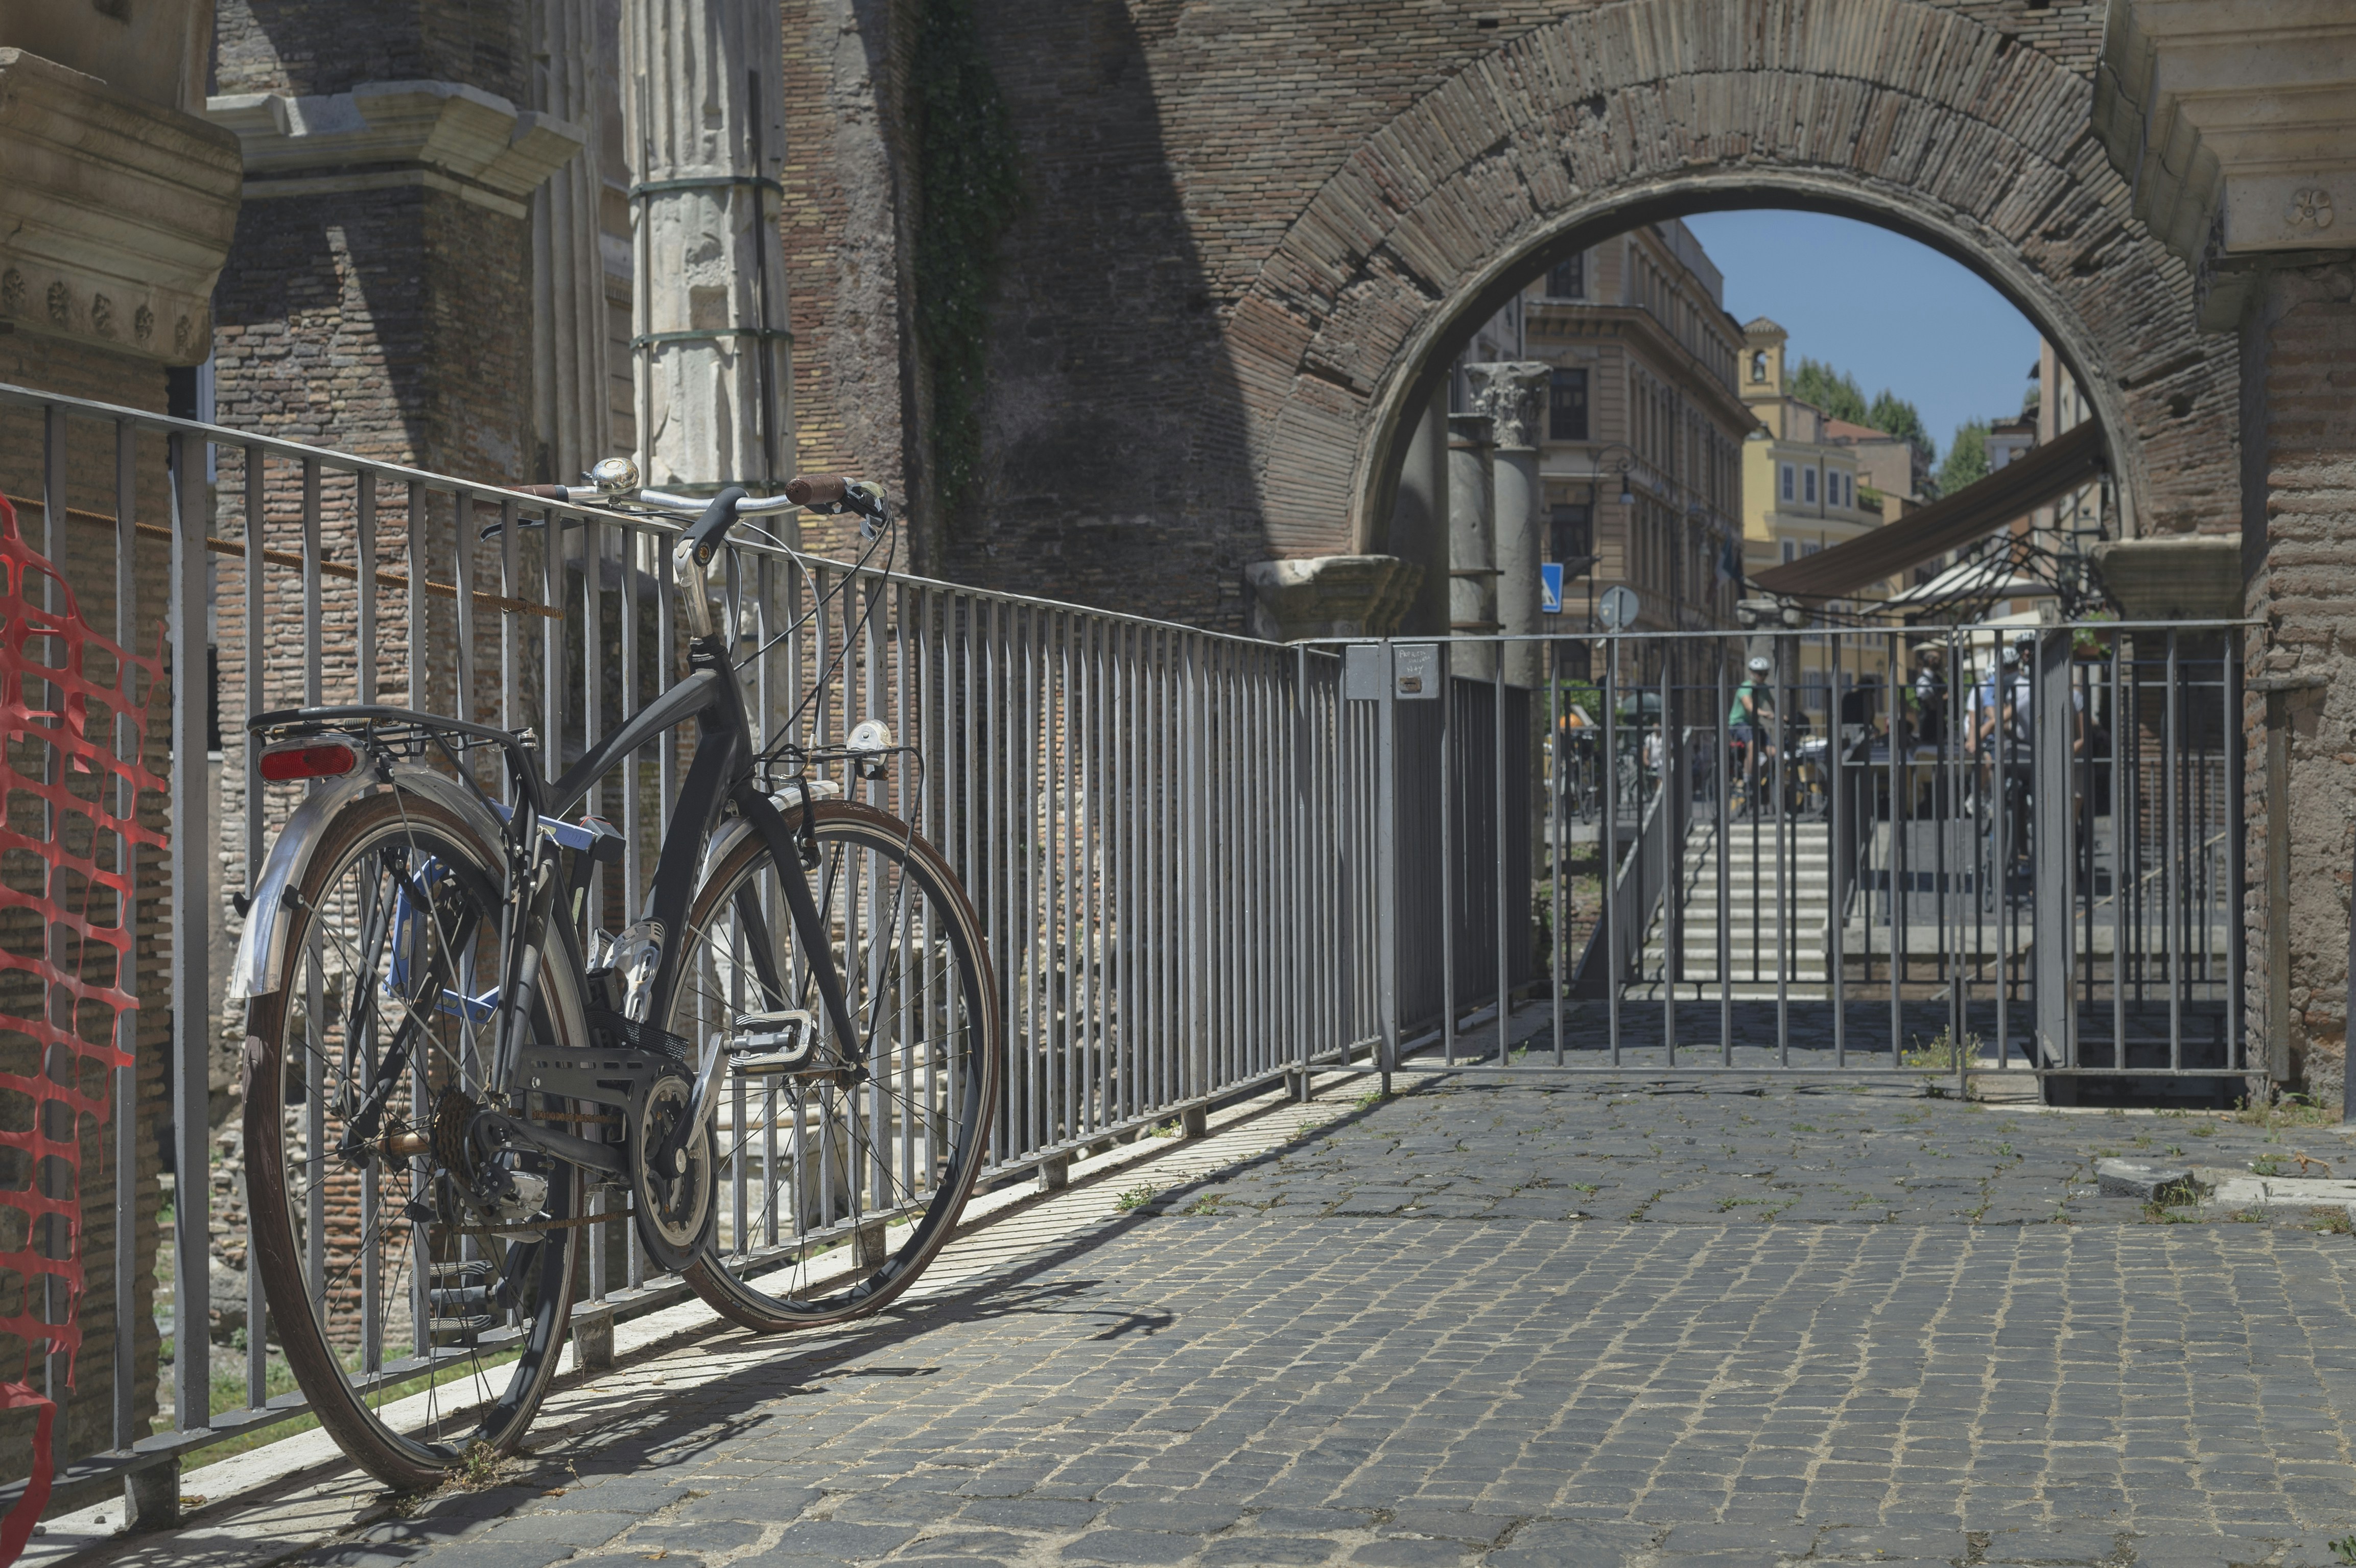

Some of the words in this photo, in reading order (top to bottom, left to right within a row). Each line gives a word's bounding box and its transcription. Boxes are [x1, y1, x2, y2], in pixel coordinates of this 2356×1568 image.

[721, 1293, 731, 1301] Delta
[741, 1306, 768, 1320] SCHWALBE
[540, 1354, 557, 1396] SCHWALBE
